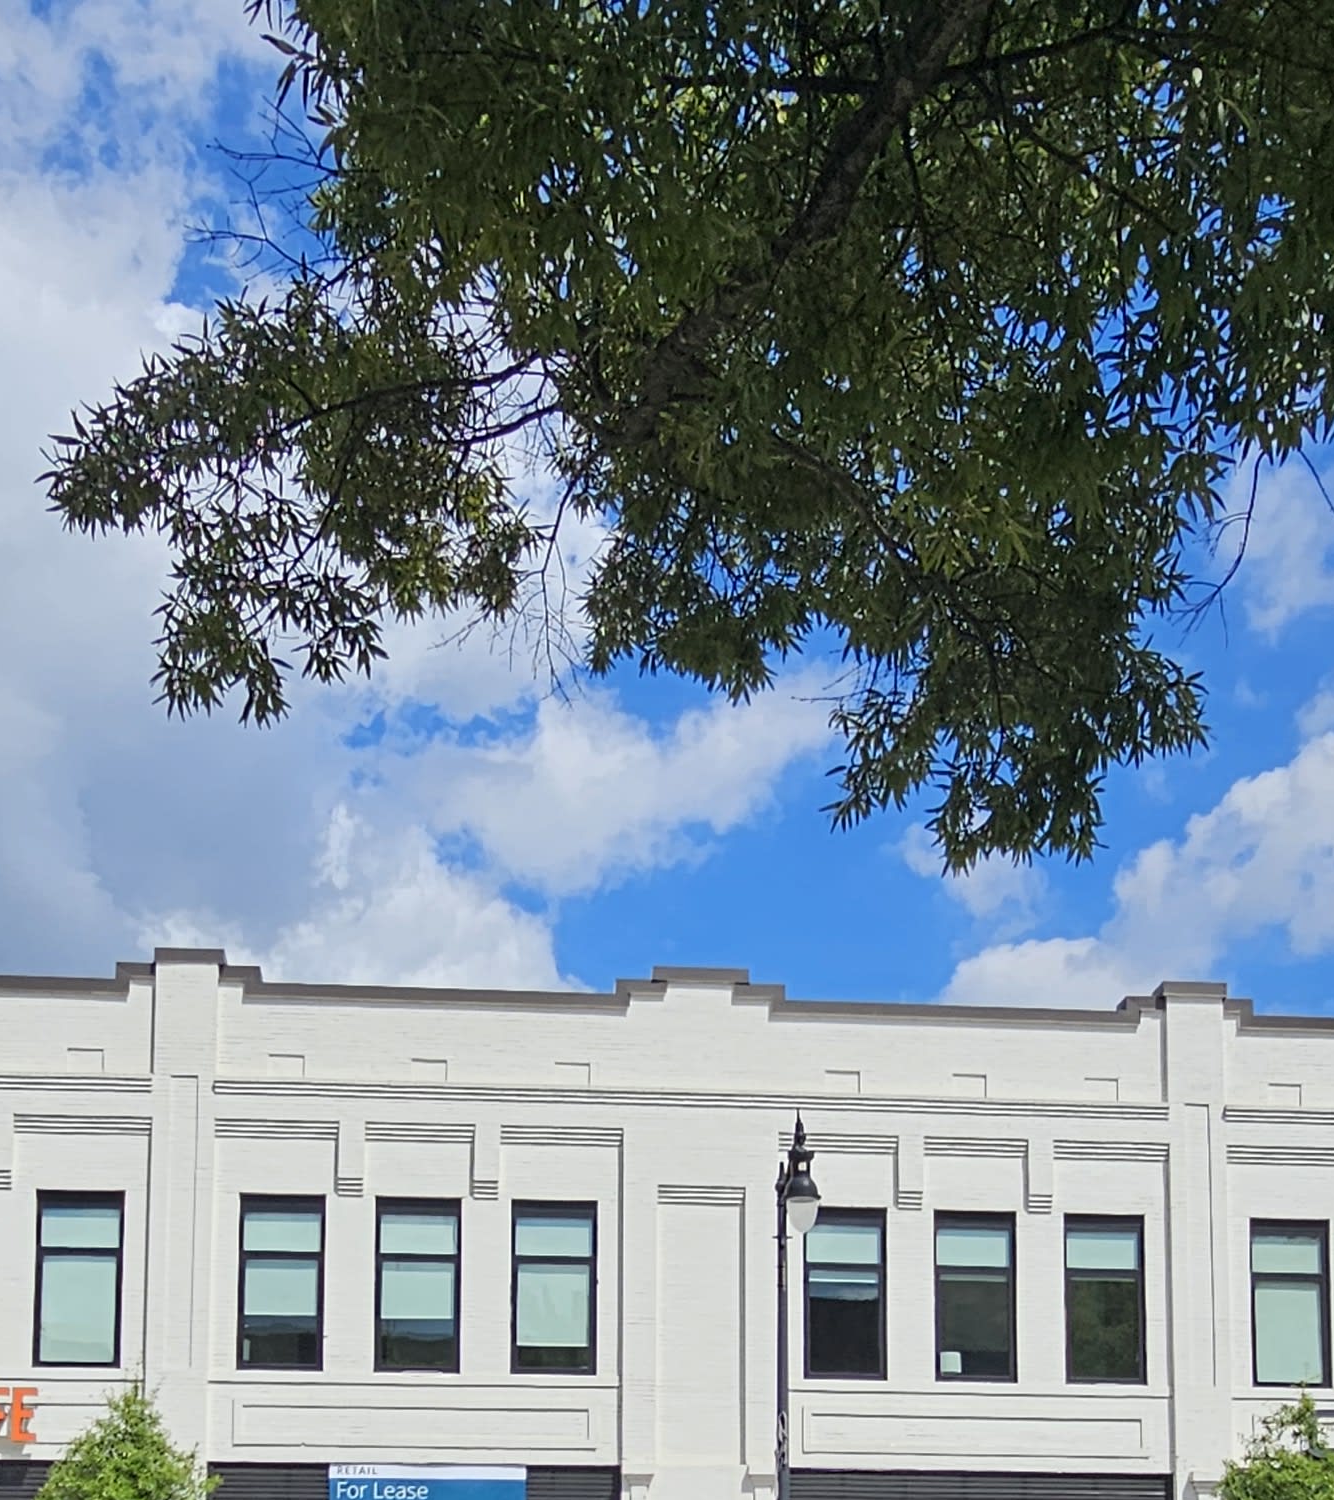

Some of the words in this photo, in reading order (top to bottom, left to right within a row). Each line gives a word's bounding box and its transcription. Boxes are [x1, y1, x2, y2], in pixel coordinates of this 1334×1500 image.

[336, 1466, 378, 1475] RETAIL
[336, 1481, 368, 1499] For
[373, 1481, 429, 1500] Lease
